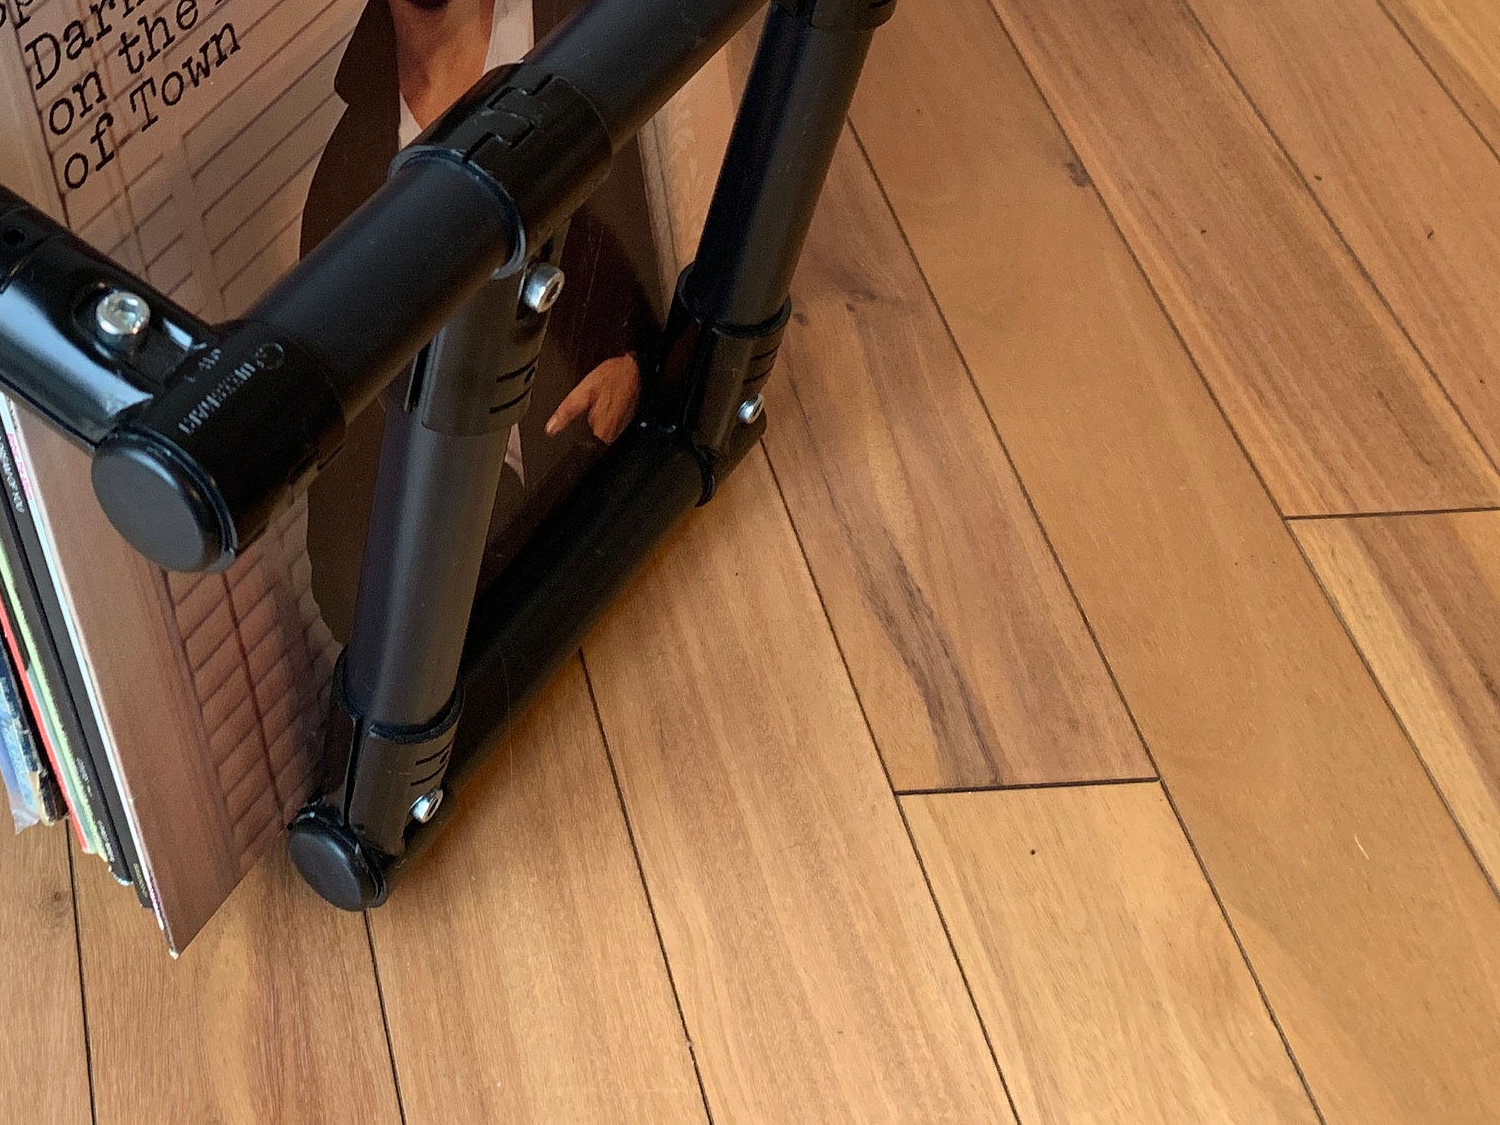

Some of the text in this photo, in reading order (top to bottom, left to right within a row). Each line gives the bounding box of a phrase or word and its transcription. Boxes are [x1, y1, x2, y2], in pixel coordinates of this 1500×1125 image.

[48, 68, 108, 136] on
[64, 21, 242, 189] of Town
